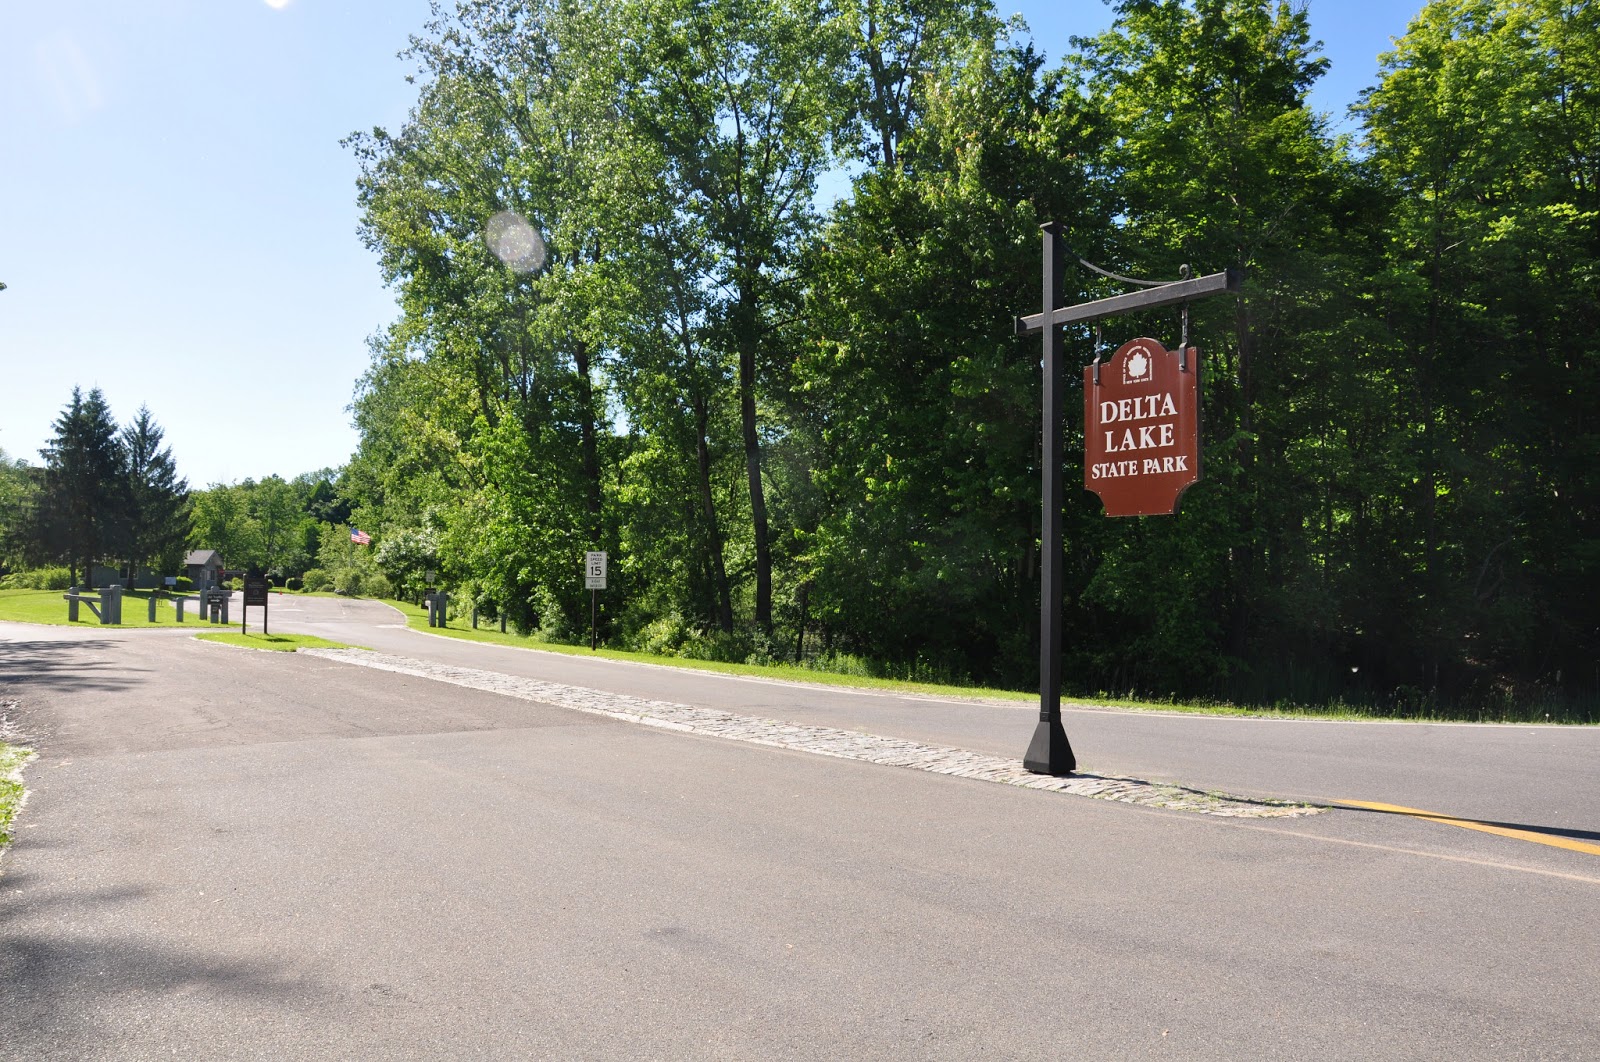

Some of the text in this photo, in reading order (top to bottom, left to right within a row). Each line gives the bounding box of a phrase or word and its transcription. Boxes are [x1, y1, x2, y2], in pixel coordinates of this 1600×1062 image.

[1100, 392, 1178, 424] DELTA
[1105, 423, 1174, 453] LAKE
[1091, 455, 1188, 480] STATE PARK
[590, 566, 602, 576] 15
